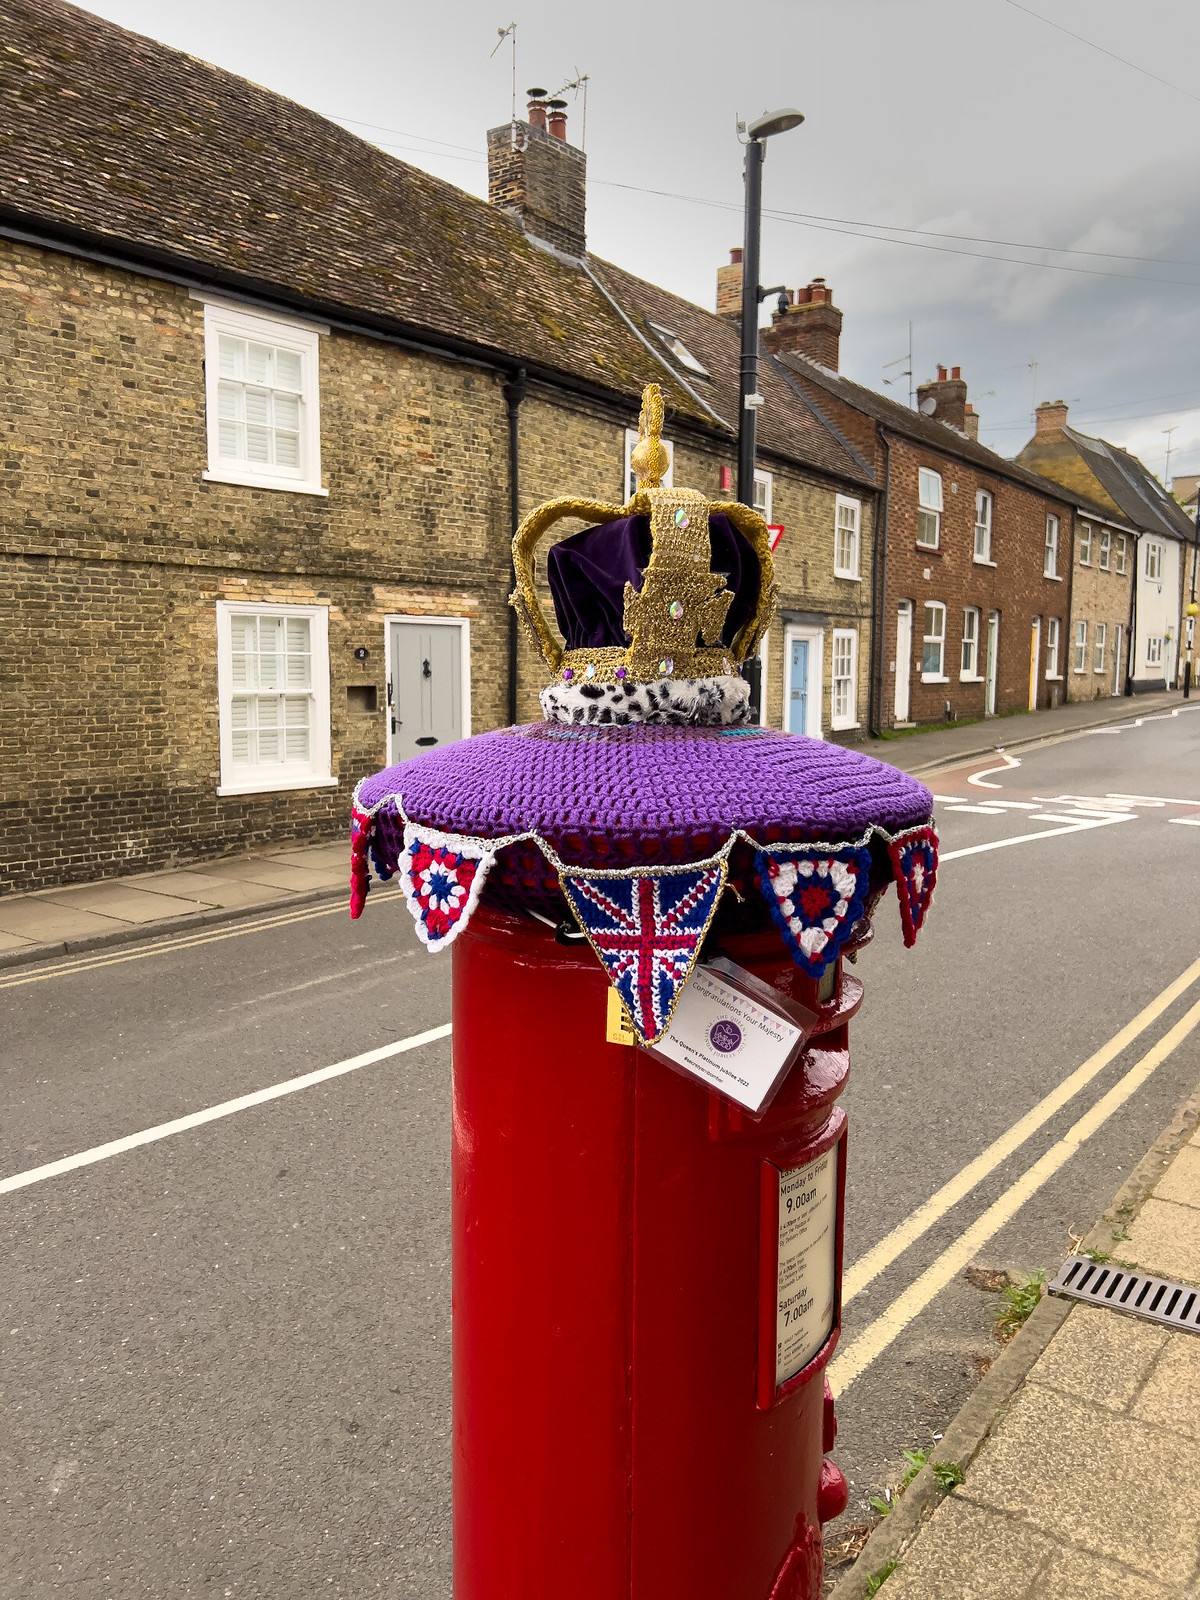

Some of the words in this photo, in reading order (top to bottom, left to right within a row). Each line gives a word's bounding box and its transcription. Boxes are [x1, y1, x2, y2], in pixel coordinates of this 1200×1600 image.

[359, 649, 365, 658] 2
[692, 981, 741, 1016] Congratulations
[742, 1012, 758, 1026] Your
[758, 1023, 784, 1043] Majesty
[669, 1034, 679, 1044] The
[679, 1041, 698, 1056] Queen's
[698, 1053, 721, 1070] Platinum
[719, 1066, 737, 1081] Jubilee
[737, 1077, 750, 1087] 2022
[780, 1177, 806, 1197] Monday
[807, 1172, 814, 1181] to
[786, 1188, 817, 1214] 9.00am
[778, 1286, 808, 1312] Saturday
[783, 1297, 814, 1328] 7.00am
